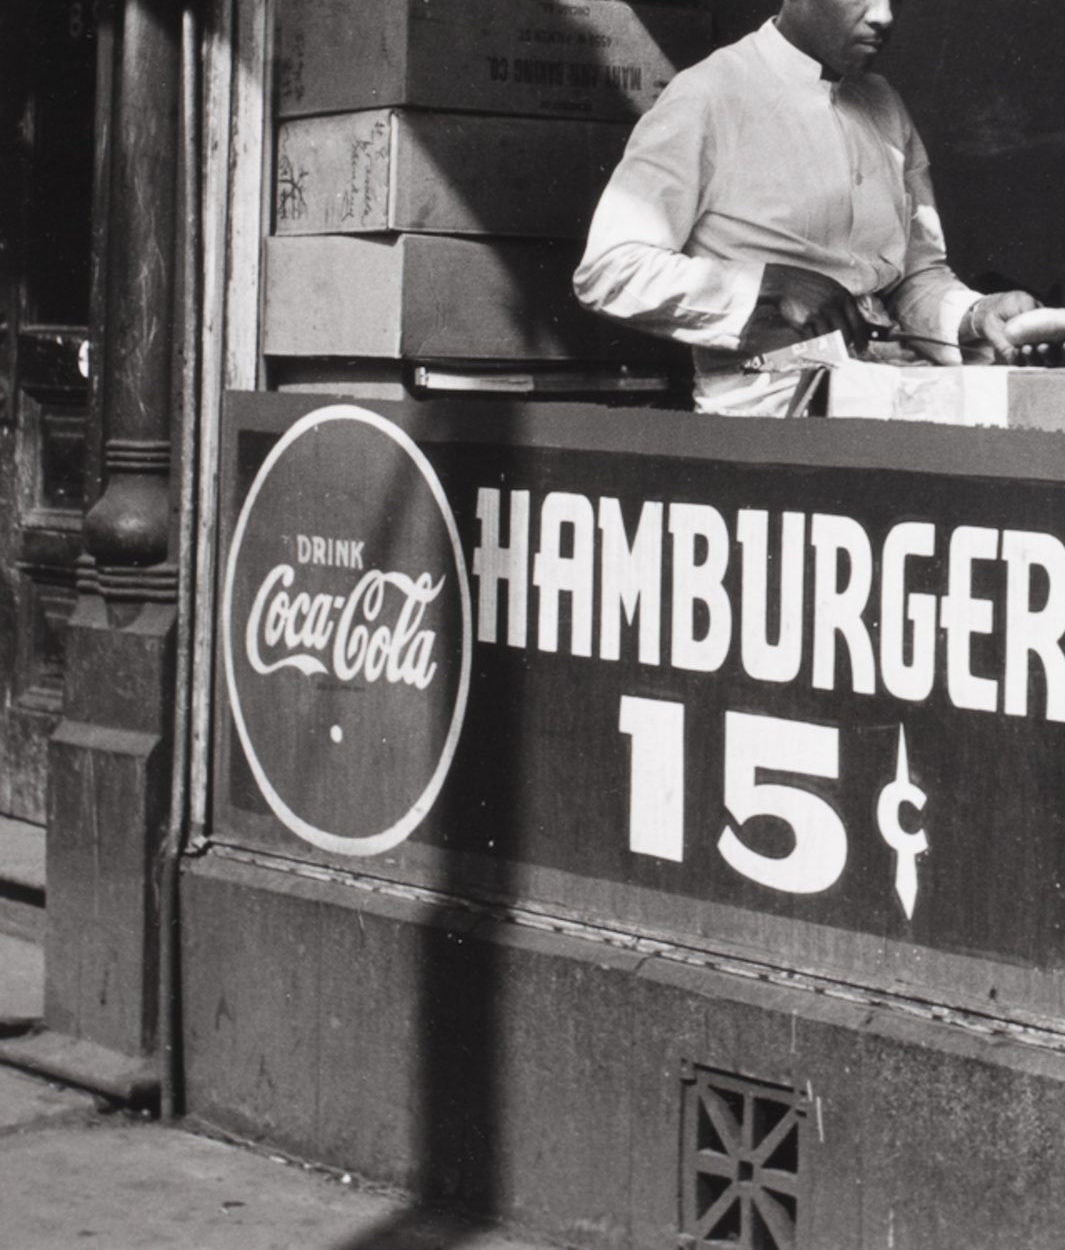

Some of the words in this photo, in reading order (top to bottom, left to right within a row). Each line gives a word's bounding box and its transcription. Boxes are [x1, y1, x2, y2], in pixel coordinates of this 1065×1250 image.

[513, 58, 564, 87] BAKING
[297, 534, 365, 570] DRINK
[246, 563, 446, 690] Coca-Cola
